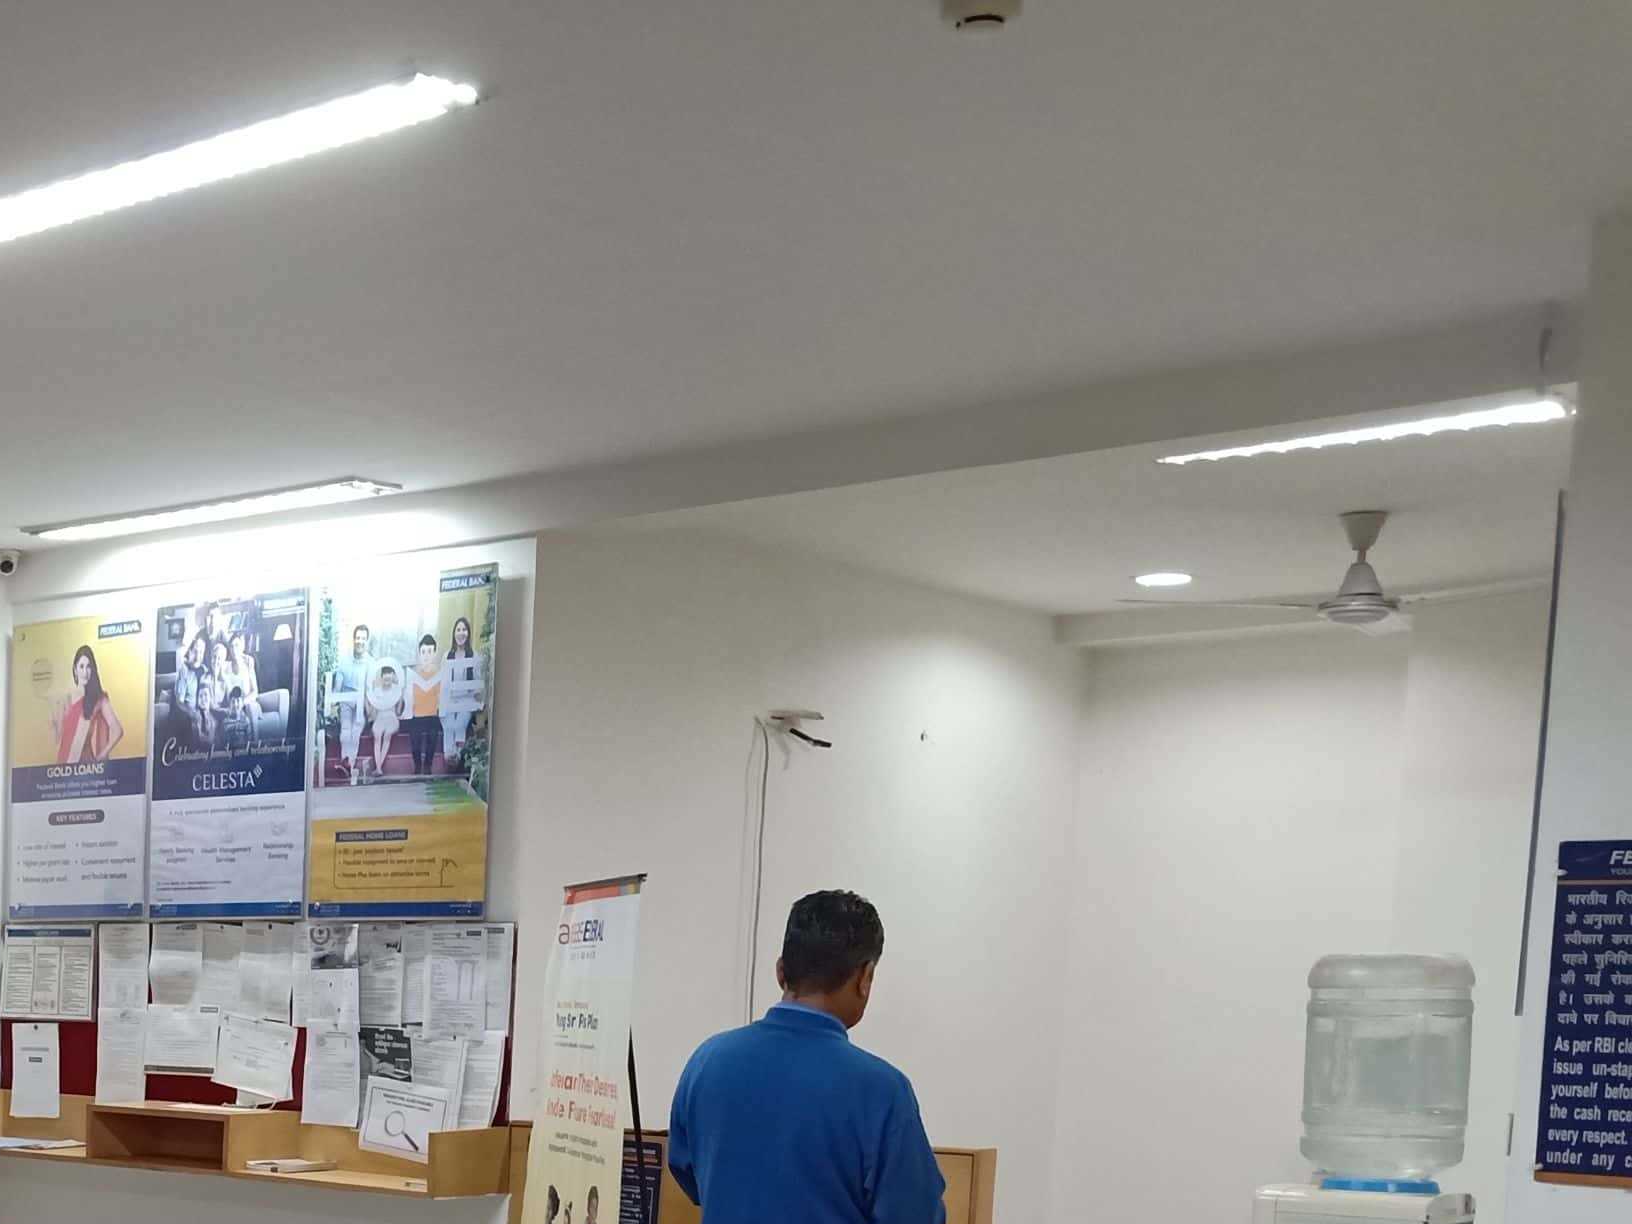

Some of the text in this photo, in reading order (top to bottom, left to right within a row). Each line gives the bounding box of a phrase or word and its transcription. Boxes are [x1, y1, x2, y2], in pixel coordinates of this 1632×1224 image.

[162, 737, 209, 766] Celebrating
[47, 763, 105, 778] GOLD LOANS
[192, 771, 256, 791] CELESTA
[56, 812, 97, 822] KEY FEATURES
[1583, 914, 1624, 929] अनुसार
[1564, 930, 1604, 945] स्वीकार
[1562, 951, 1588, 967] पहले
[1560, 969, 1576, 985] की
[1584, 971, 1601, 987] गई
[1557, 1009, 1578, 1025] दावे
[1583, 1013, 1600, 1025] पर
[1554, 1036, 1570, 1052] As
[1572, 1039, 1592, 1056] per
[1594, 1036, 1616, 1053] RBI
[1553, 1058, 1584, 1075] issue
[1550, 1081, 1598, 1101] yourself
[1549, 1103, 1568, 1119] the
[1573, 1104, 1601, 1121] cash
[1548, 1128, 1628, 1148] every respect.
[1546, 1149, 1583, 1165] under
[1591, 1153, 1616, 1171] any
